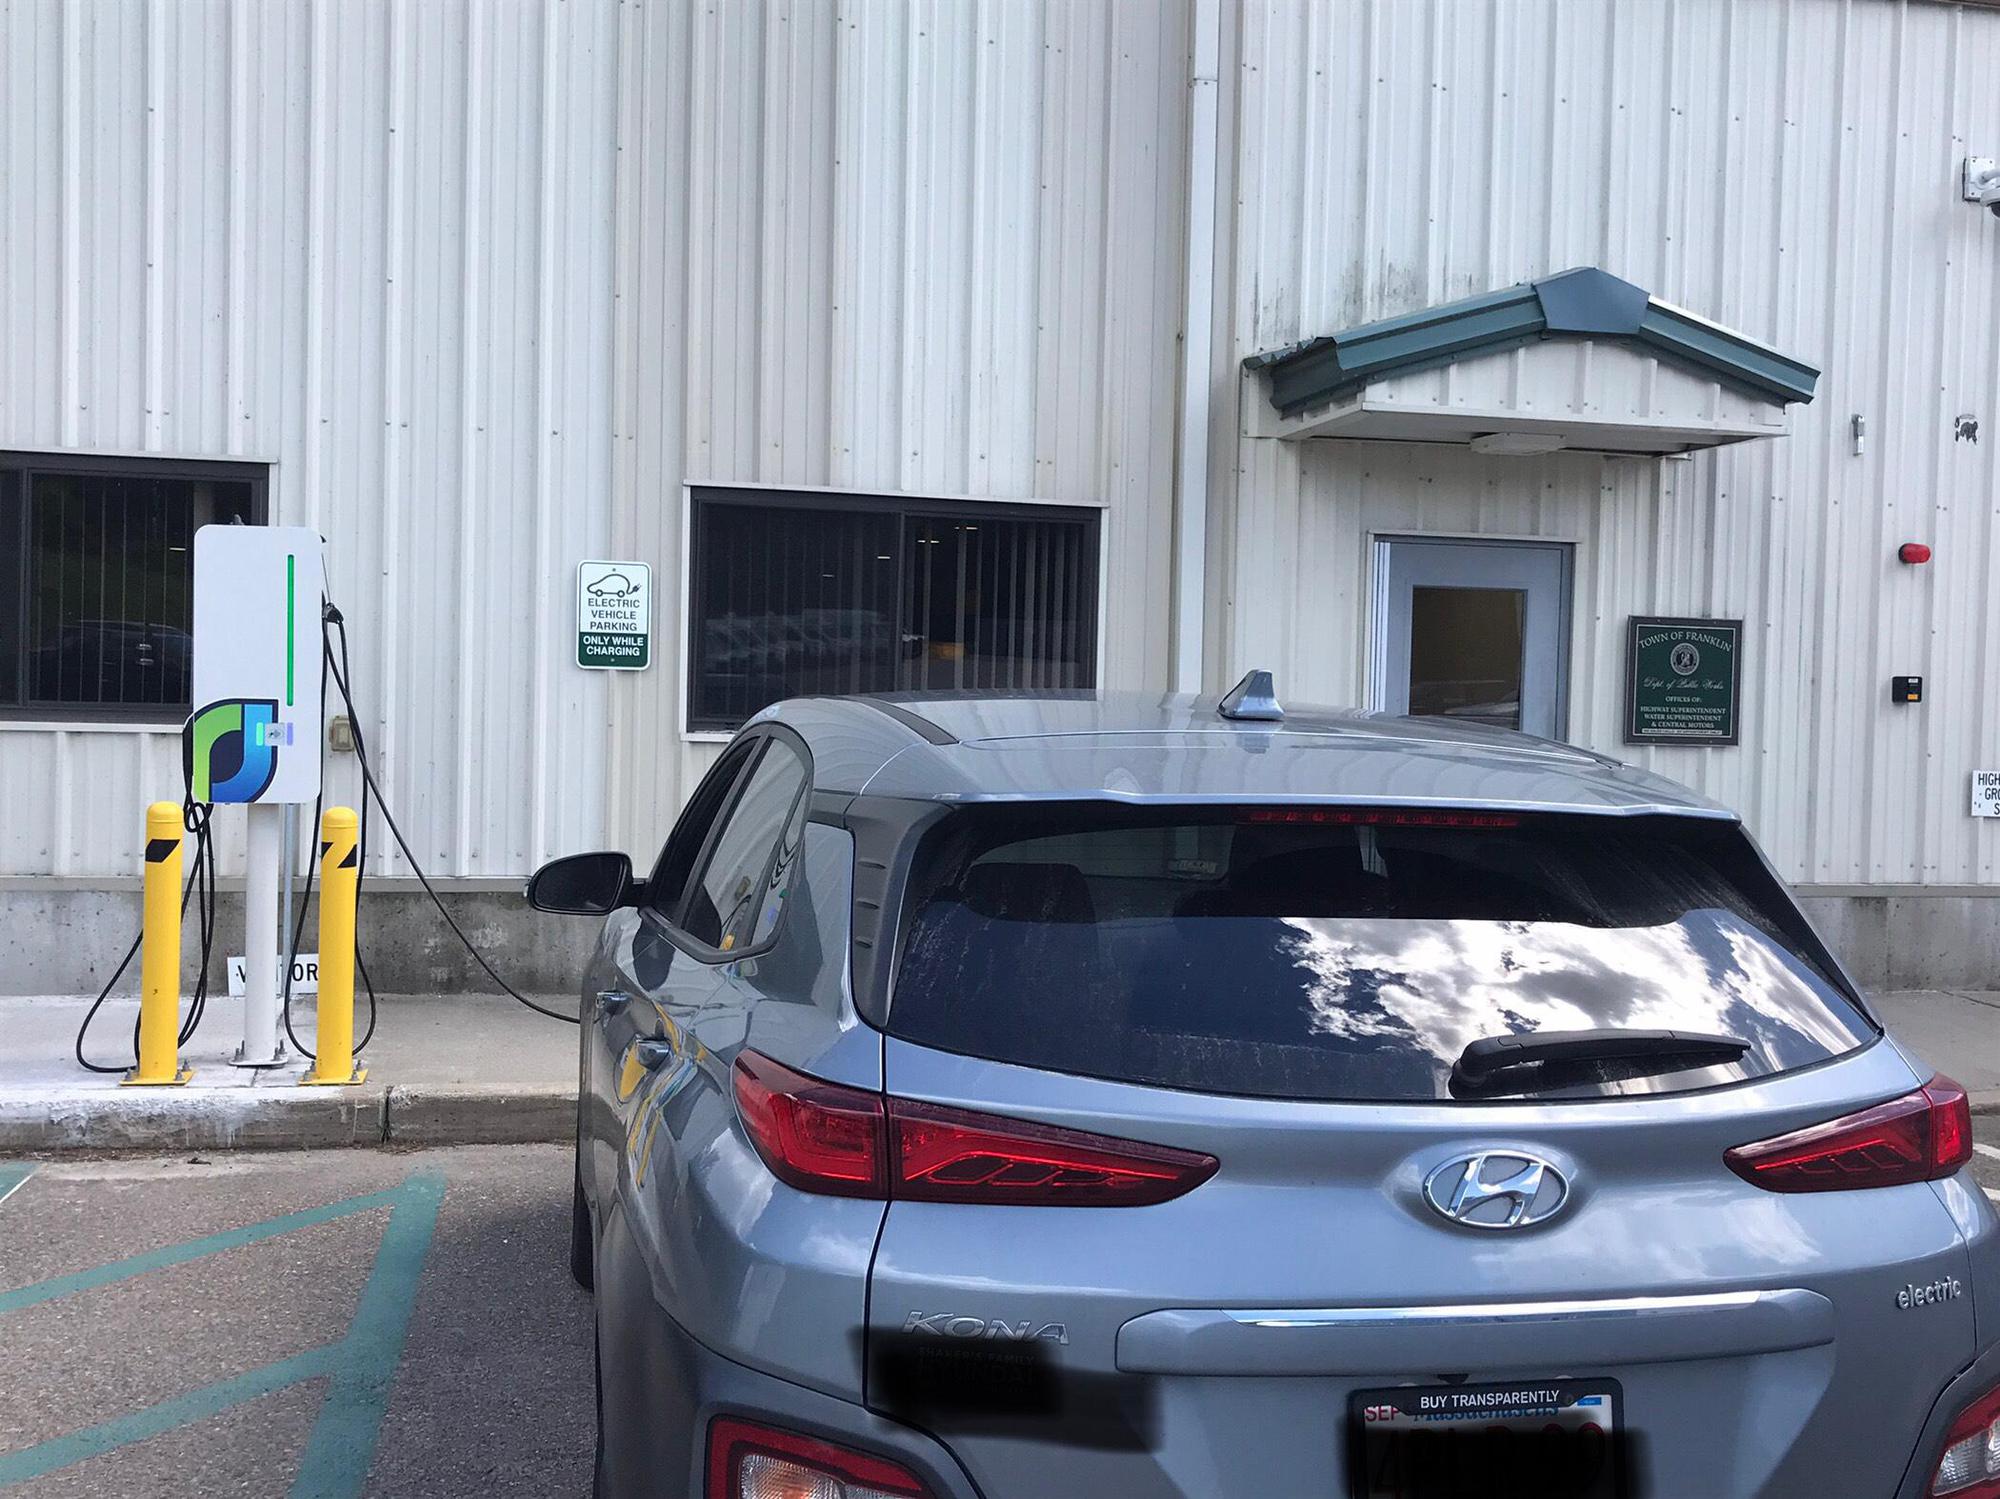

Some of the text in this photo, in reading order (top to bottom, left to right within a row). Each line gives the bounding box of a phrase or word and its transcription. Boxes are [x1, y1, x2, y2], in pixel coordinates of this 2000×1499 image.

[588, 598, 640, 608] ELECTRIC
[591, 610, 637, 620] VEHICLE
[590, 621, 637, 631] PARKING
[583, 635, 644, 646] ONLY WHILE
[1639, 631, 1732, 652] TOWN OF FRANKLIN
[586, 646, 640, 656] CHARGING
[1670, 706, 1726, 714] SUPERINTENDENT
[1896, 1275, 1961, 1310] electric
[902, 1311, 1070, 1345] KONA
[1420, 1390, 1560, 1409] BUY TRANSPARENTLY
